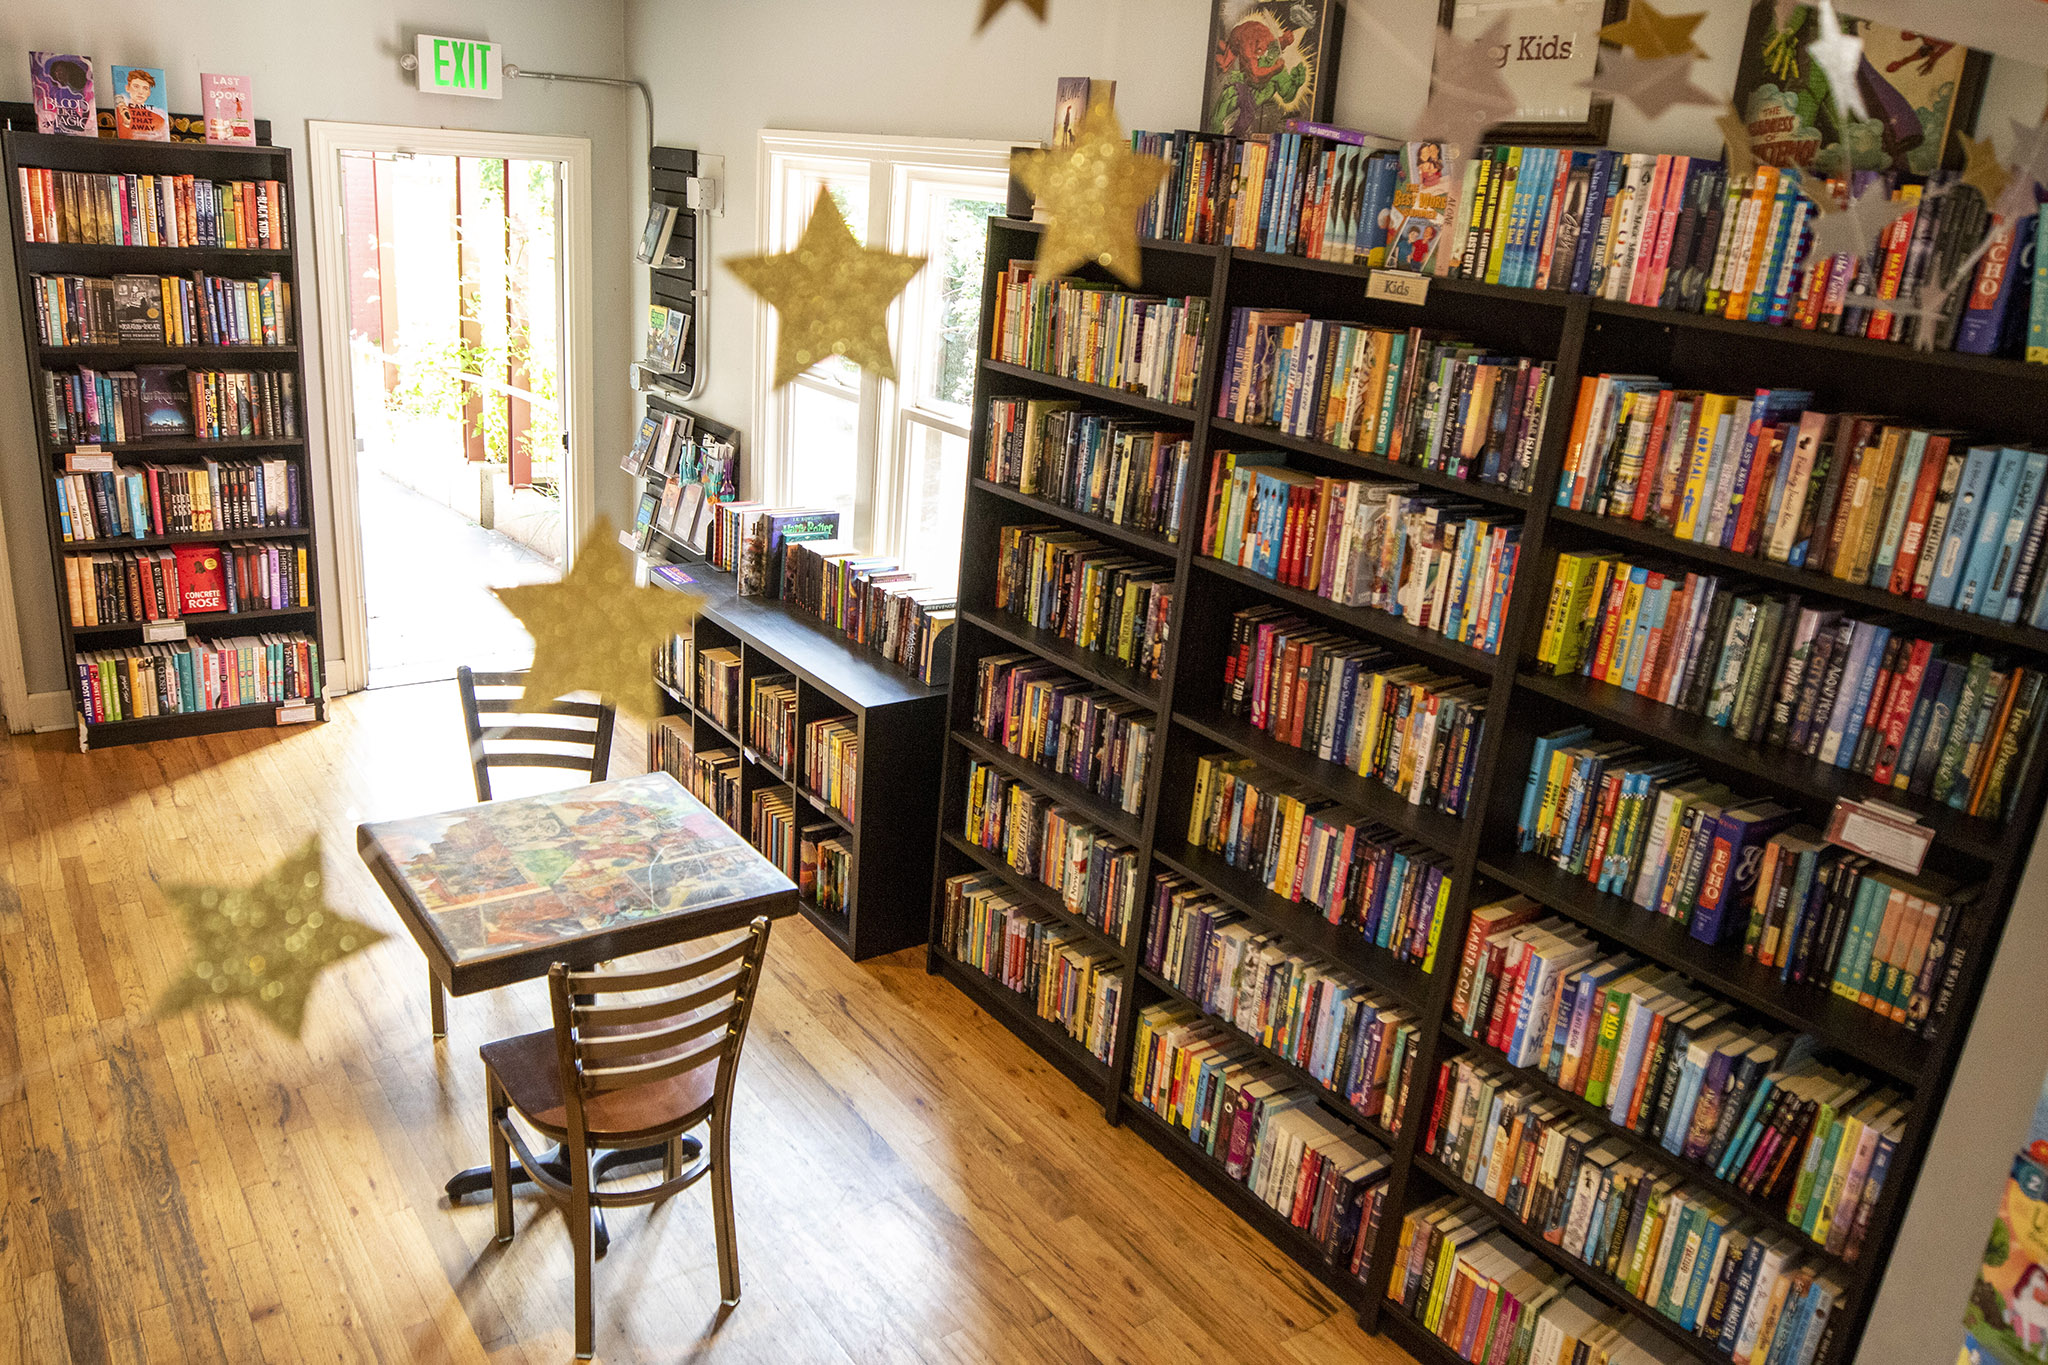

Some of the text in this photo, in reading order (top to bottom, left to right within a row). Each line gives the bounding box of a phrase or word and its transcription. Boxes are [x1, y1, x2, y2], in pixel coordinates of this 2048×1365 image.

[1516, 34, 1573, 61] Kids
[433, 39, 491, 90] EXIT
[212, 76, 241, 86] LAST
[43, 98, 90, 113] BLOOD
[128, 103, 155, 111] CAN'T
[131, 110, 153, 118] TAKE
[48, 117, 88, 129] MAGIC
[131, 124, 156, 132] AWAY
[1393, 190, 1416, 207] BEST
[1442, 196, 1457, 227] ALONE
[1580, 169, 1603, 235] Star Shepherd
[254, 194, 270, 239] BLACK KIDS
[1463, 158, 1491, 275] CHARLIE THORNE LOST CITY
[1475, 177, 1500, 278] CHARLIE THORNE LAST EQUATION
[1492, 184, 1512, 249] bear bottom
[1629, 214, 1642, 238] MAGIC
[1591, 214, 1611, 272] WON'T DANCE
[1886, 251, 1903, 278] MAX
[1384, 280, 1409, 296] Kids
[250, 384, 260, 408] DRY
[1376, 374, 1396, 444] DRESS CODED
[1688, 424, 1711, 483] NORMAL
[222, 502, 231, 524] PROJECT
[232, 501, 241, 523] PROJECT
[240, 500, 249, 522] PROJECT
[806, 522, 834, 535] Potter
[1900, 520, 1924, 556] BLOOM
[1921, 513, 1945, 563] INKLING
[184, 589, 221, 601] CONCRETE
[188, 597, 219, 609] ROSE
[1702, 847, 1730, 902] ECHO
[1452, 922, 1484, 1015] AMBER & CLAY
[1602, 1013, 1620, 1040] KID
[1630, 1214, 1654, 1272] ROCK ON
